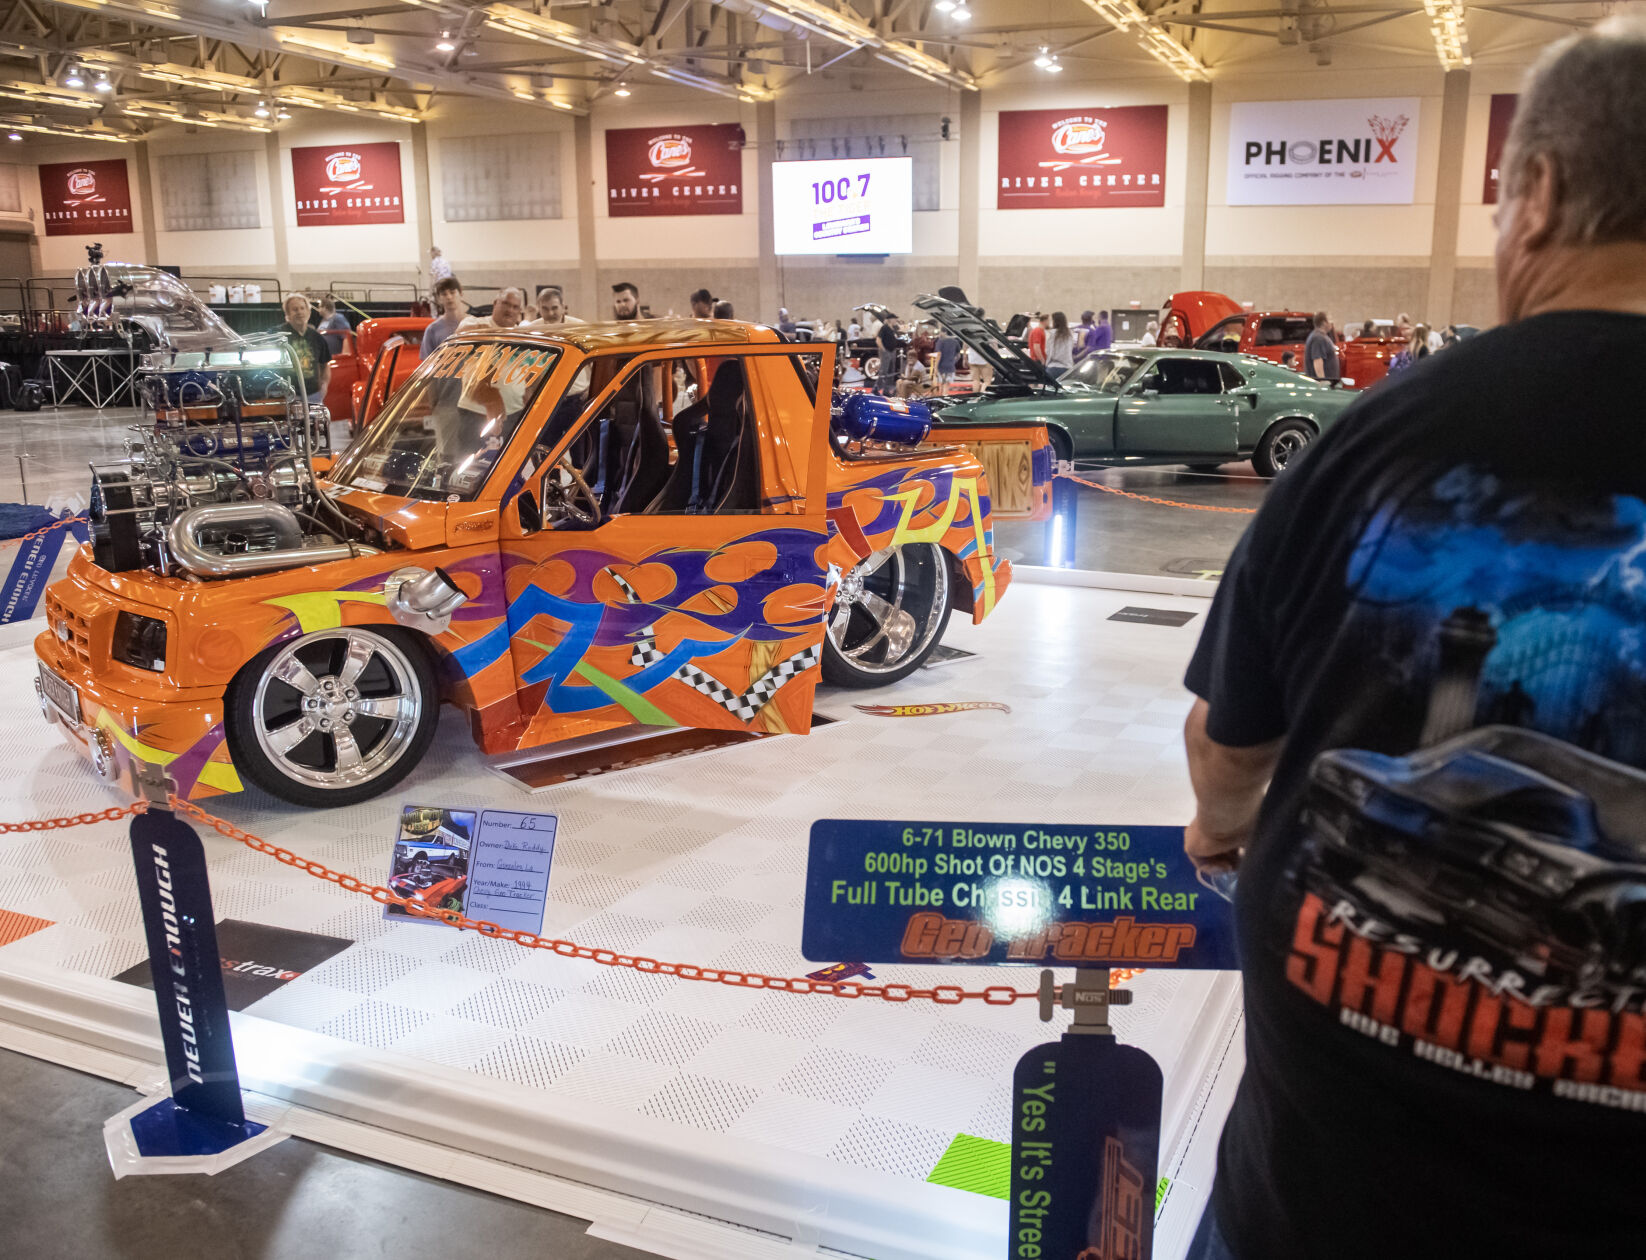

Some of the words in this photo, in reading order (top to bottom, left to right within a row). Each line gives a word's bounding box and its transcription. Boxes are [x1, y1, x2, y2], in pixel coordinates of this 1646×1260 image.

[1245, 138, 1398, 166] PHOENIX
[610, 187, 660, 198] RIVER
[672, 185, 738, 197] CENTER
[812, 173, 871, 205] 100.7
[1001, 175, 1063, 188] RIVER
[1079, 173, 1160, 187] CENTER
[45, 210, 78, 219] RIVER
[85, 207, 128, 218] CENTER
[297, 199, 338, 210] RIVER
[347, 196, 400, 208] CENTER
[482, 820, 512, 829] Number:
[520, 816, 537, 830] 65
[903, 828, 944, 847] 6-71
[952, 829, 1016, 850] Blown
[1022, 830, 1088, 855] Chevy
[1094, 831, 1130, 851] 350
[864, 852, 928, 879] 600hp
[934, 853, 983, 877] Shot
[989, 853, 1015, 877] Of
[1020, 854, 1067, 878] NOS
[1073, 857, 1086, 877] 4
[1092, 857, 1167, 883] Stage's
[474, 879, 510, 889] Year/Make:
[831, 880, 876, 905] Full
[885, 882, 944, 907] Tube
[951, 883, 1052, 908] Chssi
[1058, 886, 1072, 909] 4
[1080, 886, 1132, 911] Link
[1141, 887, 1198, 912] Rear
[152, 842, 186, 976] ENOUGH
[469, 901, 489, 910] Class:
[900, 911, 995, 960] Geo
[220, 956, 285, 979] strax
[172, 981, 204, 1085] NEVER
[1021, 1083, 1055, 1132] Yes
[1553, 1079, 1646, 1113] RACI
[1020, 1141, 1053, 1181] It's
[1017, 1189, 1051, 1260] Stree
